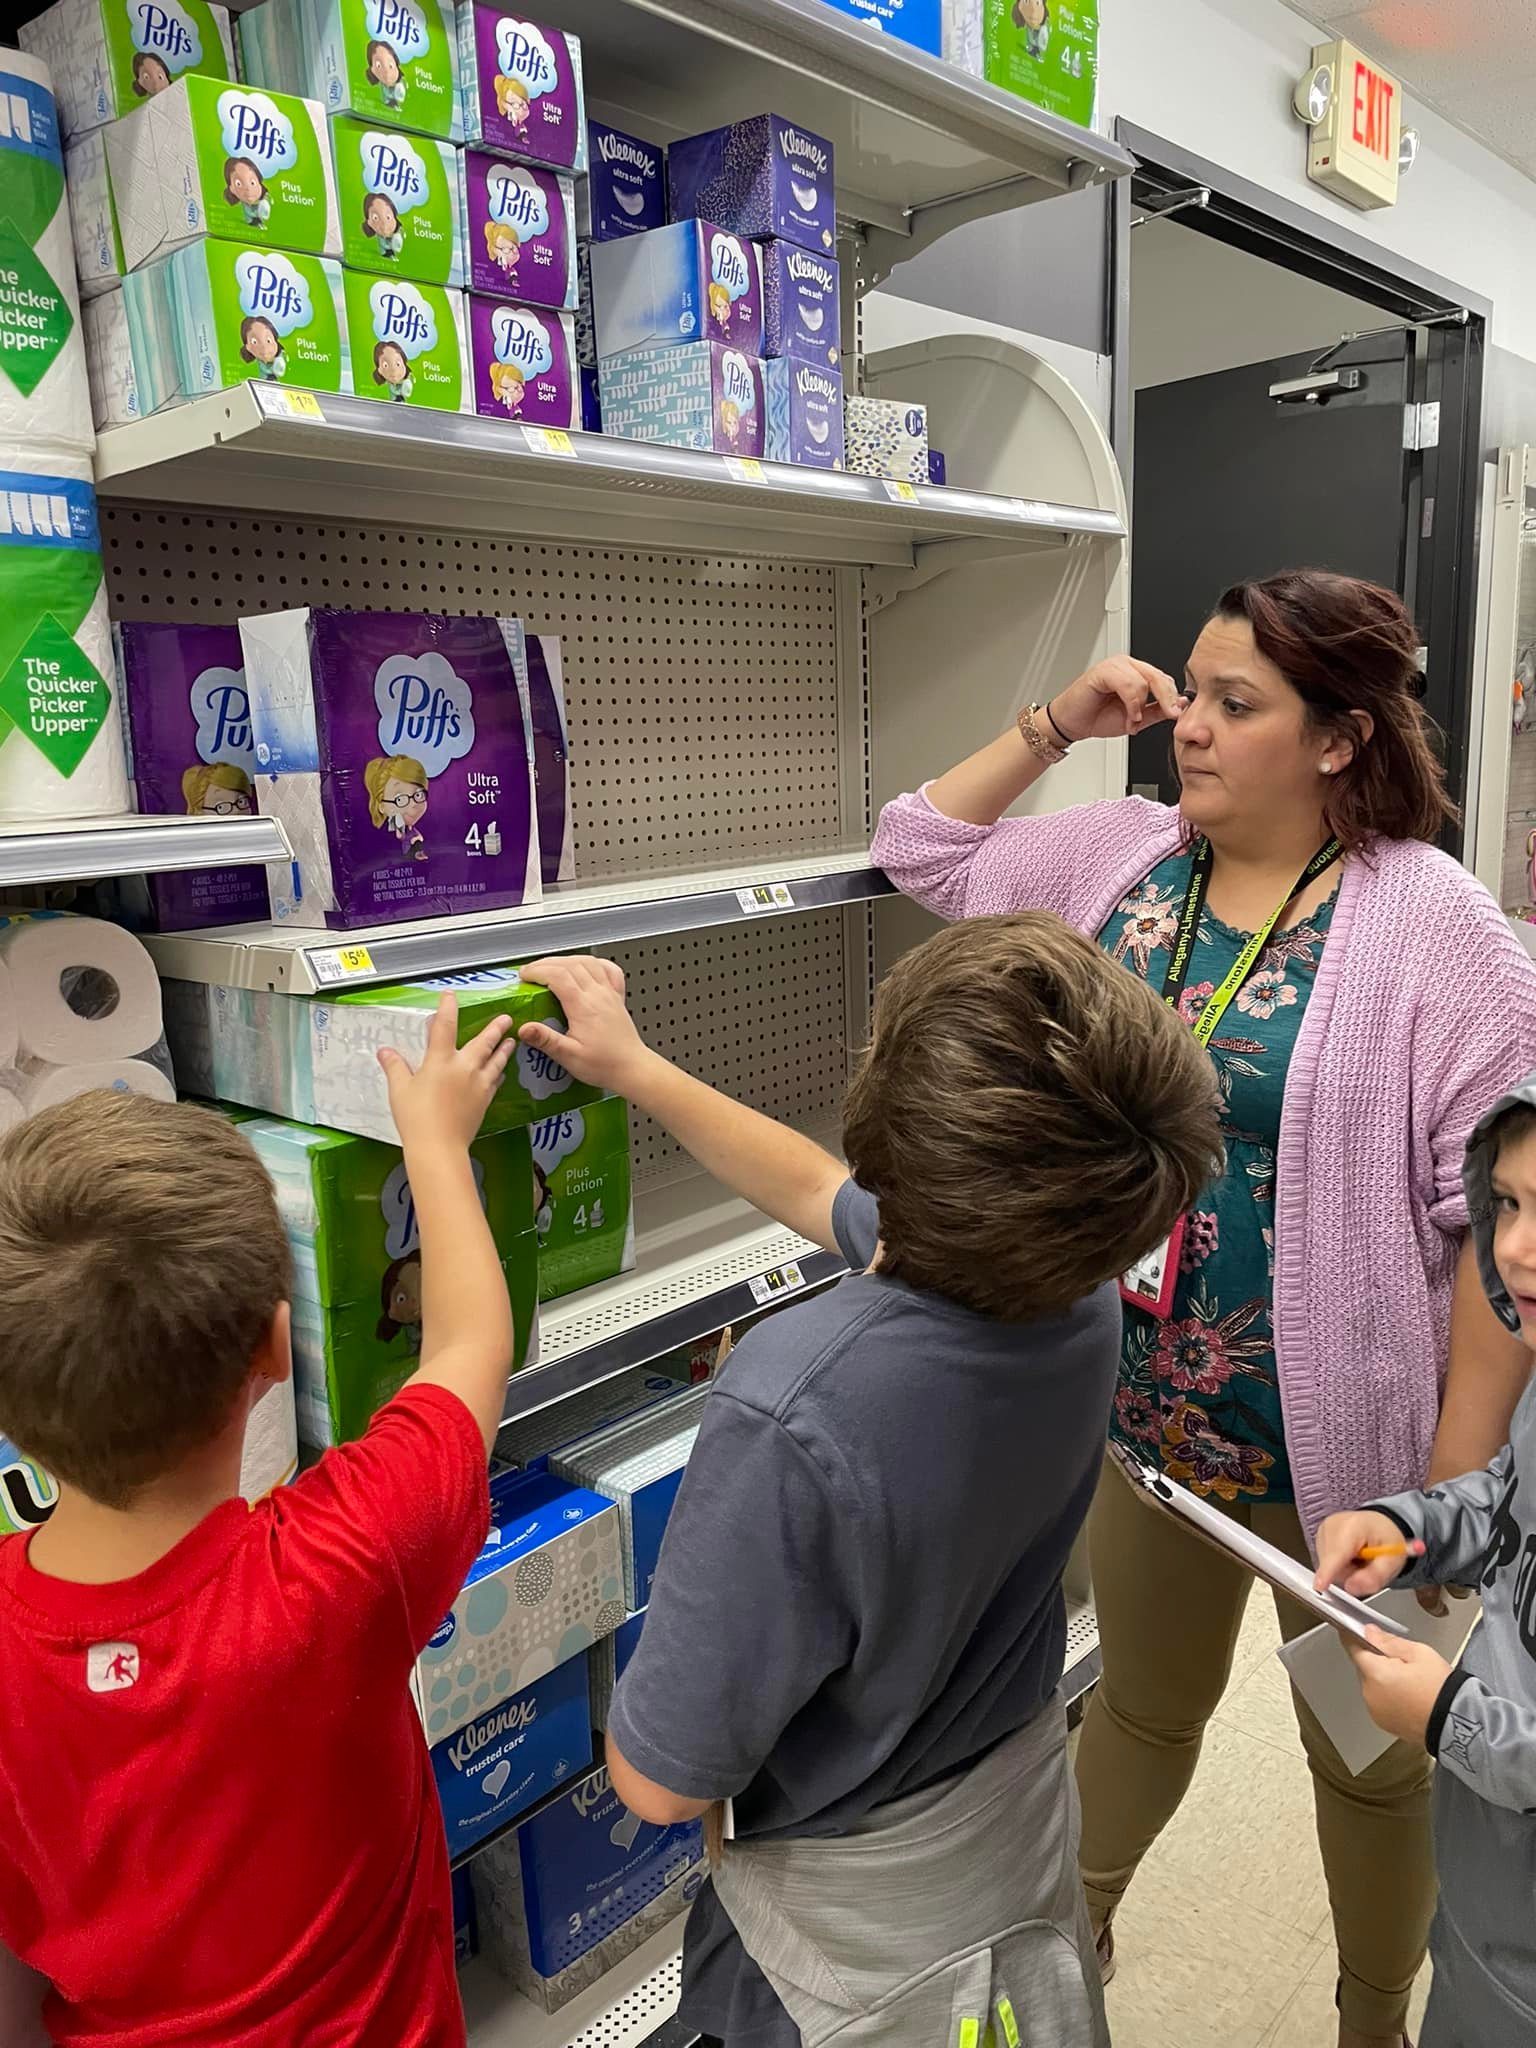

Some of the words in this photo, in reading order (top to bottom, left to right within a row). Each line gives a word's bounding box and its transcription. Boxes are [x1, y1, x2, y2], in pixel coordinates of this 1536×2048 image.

[138, 3, 192, 55] Puffs
[374, 0, 420, 46] Puffs
[505, 32, 549, 82] Puffs
[1061, 45, 1071, 69] 4
[415, 67, 432, 80] Plus
[416, 78, 444, 94] Lotion
[542, 101, 562, 115] Ultra
[543, 111, 561, 125] Soft
[1353, 60, 1393, 161] EXIT
[230, 105, 287, 159] Puffs
[598, 134, 655, 176] Kleenex
[780, 128, 827, 172] Kleenex
[371, 144, 420, 197] Puffs
[613, 168, 629, 181] ultra
[629, 175, 643, 186] soft
[792, 163, 805, 176] ultra
[806, 170, 817, 181] soft
[281, 180, 301, 193] Plus
[282, 192, 315, 207] Lotion
[496, 177, 540, 225] Puffs
[413, 216, 432, 228] Plus
[414, 227, 444, 242] Lotion
[533, 244, 553, 256] Ultra
[533, 254, 552, 266] Soft
[717, 245, 745, 287] Puffs
[787, 252, 833, 292] Kleenex
[0, 269, 18, 285] he
[0, 287, 58, 311] uicker
[247, 264, 302, 318] Puffs
[799, 286, 812, 298] ultra
[0, 306, 48, 330] icker
[381, 294, 428, 342] Puffs
[739, 303, 752, 313] Ultra
[0, 328, 48, 351] pper
[297, 337, 317, 350] Plus
[501, 319, 544, 364] Puffs
[298, 349, 329, 363] Lotion
[423, 361, 440, 373] Plus
[423, 372, 451, 384] Lotion
[537, 381, 557, 393] Ultra
[727, 362, 751, 402] Puffs
[796, 367, 837, 404] Kleenex
[538, 391, 555, 402] Soft
[23, 659, 60, 676] The
[26, 676, 98, 696] Quicker
[29, 696, 87, 715] Picker
[389, 674, 461, 748] Puffs
[31, 716, 89, 736] Upper
[467, 772, 499, 788] Ultra
[465, 822, 482, 849] 4
[1168, 873, 1203, 982] Allegany-Limestone
[566, 1166, 590, 1181] Plus
[567, 1177, 603, 1196] Lotion
[573, 1204, 588, 1228] 4
[448, 1698, 537, 1772] Kleenex
[466, 1746, 502, 1777] trusted
[503, 1733, 527, 1754] care
[568, 1912, 583, 1938] 3
